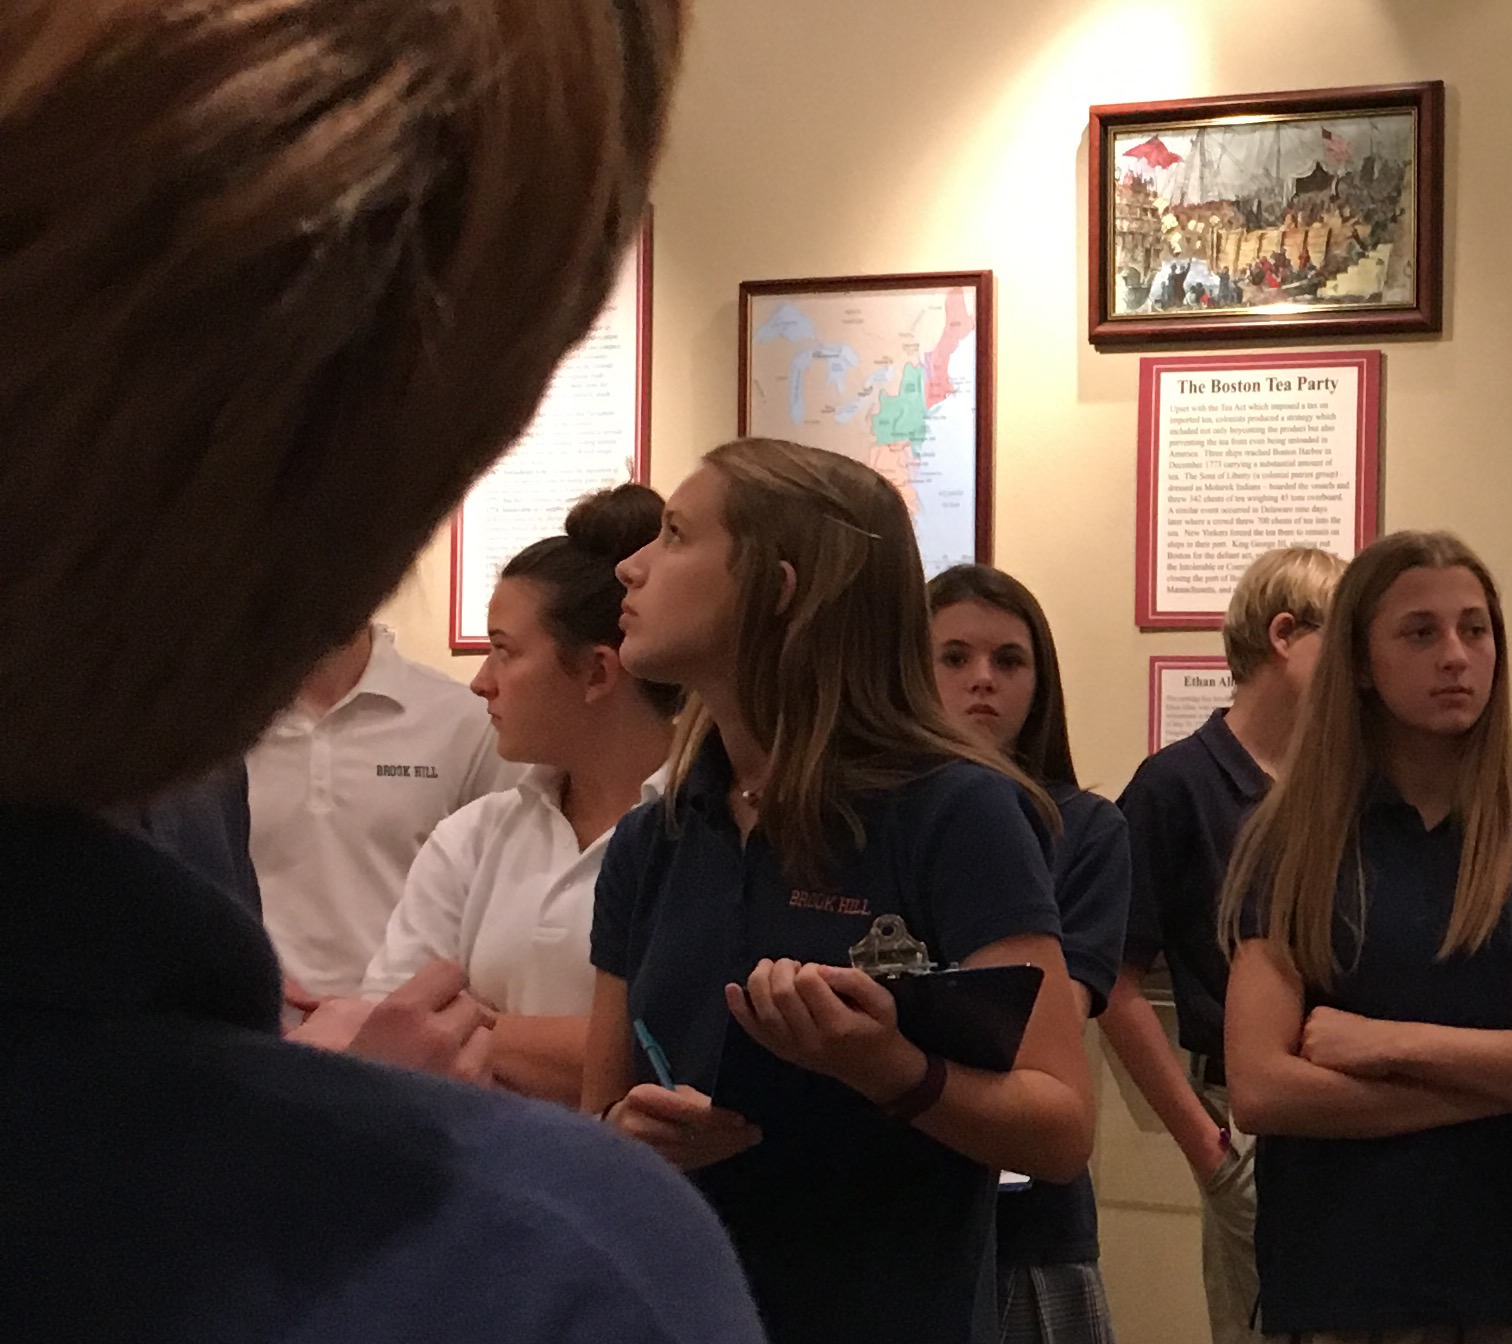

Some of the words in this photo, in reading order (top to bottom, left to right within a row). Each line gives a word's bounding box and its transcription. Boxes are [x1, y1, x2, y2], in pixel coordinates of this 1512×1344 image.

[1177, 379, 1206, 394] The
[1211, 378, 1261, 394] Boston
[1266, 376, 1292, 392] Tea
[1297, 376, 1339, 394] Party
[1184, 676, 1216, 687] Ethan
[376, 764, 410, 777] BROOK
[414, 766, 438, 778] HILL
[789, 889, 835, 911] BROOK
[838, 896, 871, 916] HILL
